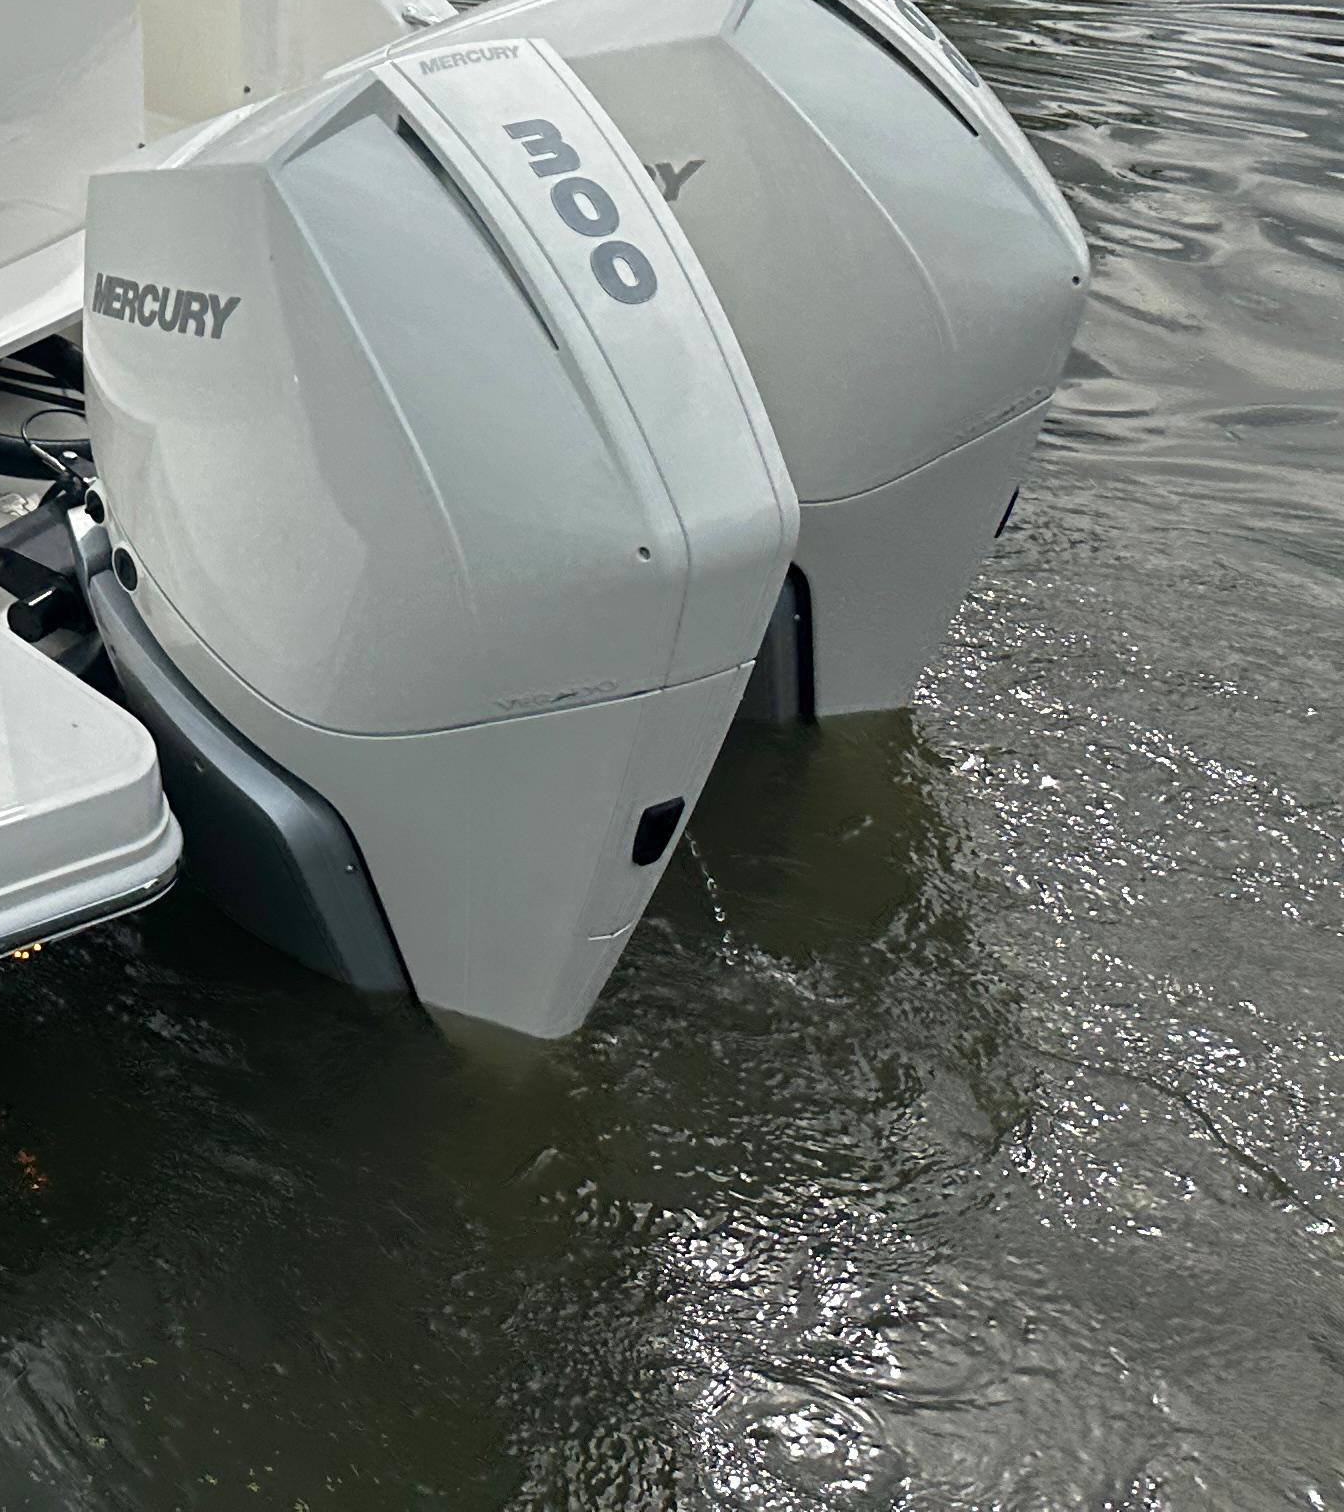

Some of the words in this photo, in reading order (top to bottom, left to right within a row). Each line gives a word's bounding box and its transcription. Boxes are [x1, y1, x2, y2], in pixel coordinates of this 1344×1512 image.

[419, 45, 521, 75] MERCURY
[502, 118, 658, 305] 300
[92, 272, 242, 339] MERCURY
